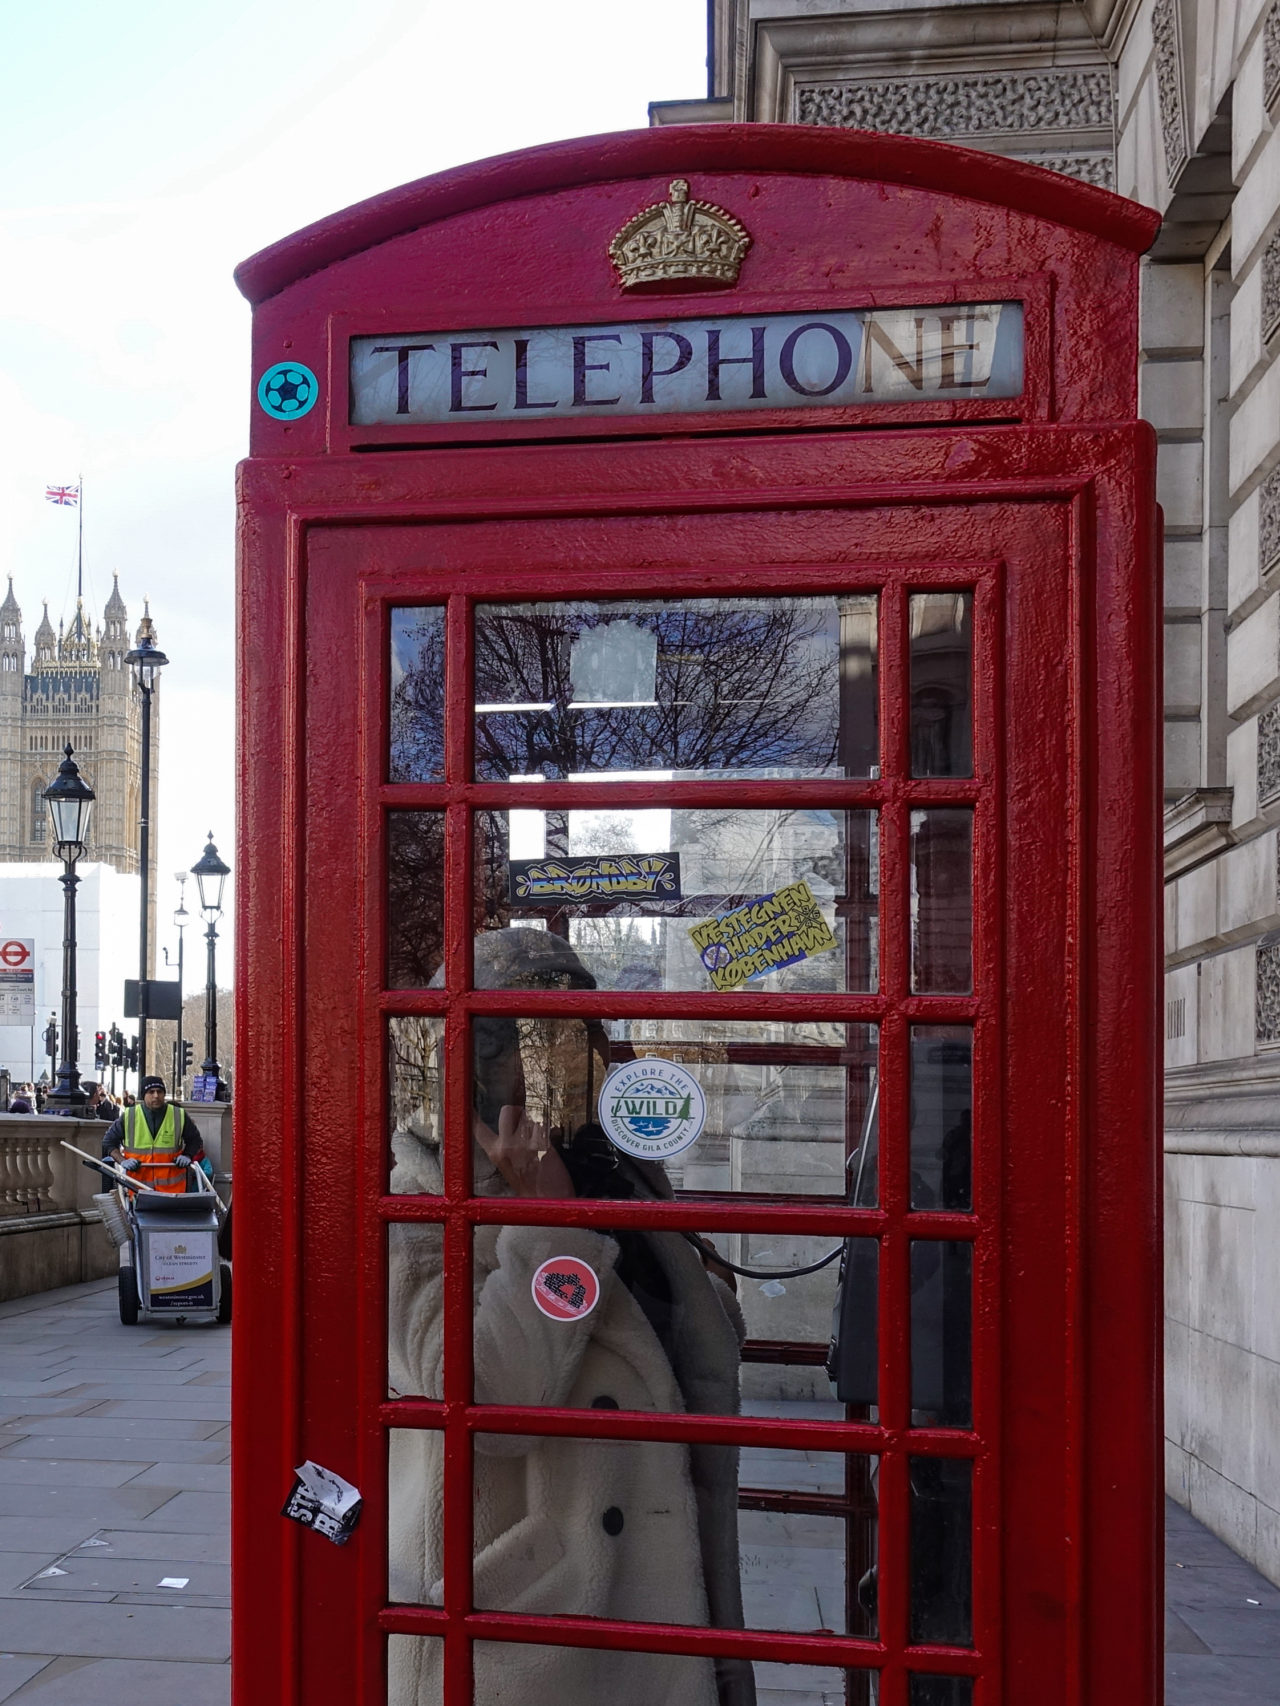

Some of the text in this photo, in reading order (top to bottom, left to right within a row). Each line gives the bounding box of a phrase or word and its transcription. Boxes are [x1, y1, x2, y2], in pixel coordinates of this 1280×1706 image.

[371, 313, 993, 415] TELEPHONE
[691, 882, 810, 949] VESTEGNEN
[725, 913, 797, 957] HADER
[710, 921, 832, 990] KØBENHAVN
[615, 1068, 689, 1093] EXPLORE THE
[624, 1100, 678, 1116] WILD
[611, 1118, 689, 1152] DISCOVER GILA COUNTY
